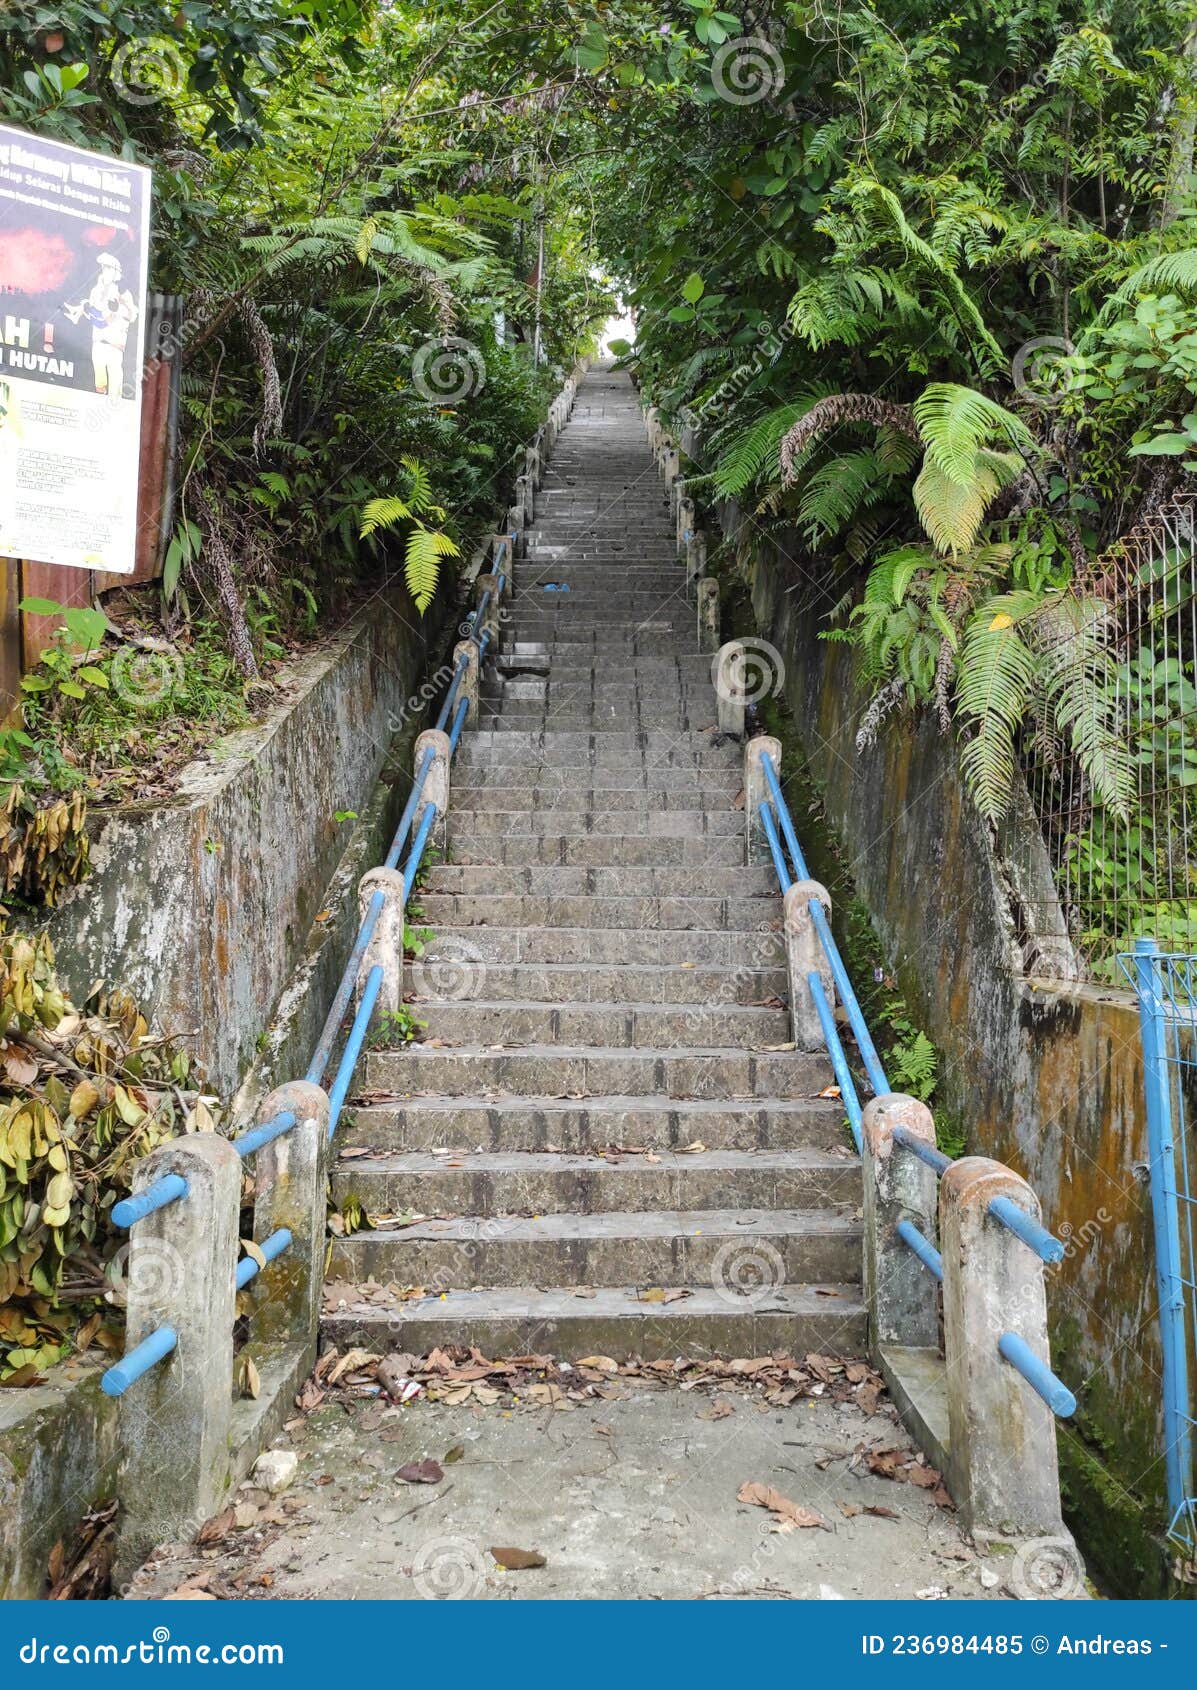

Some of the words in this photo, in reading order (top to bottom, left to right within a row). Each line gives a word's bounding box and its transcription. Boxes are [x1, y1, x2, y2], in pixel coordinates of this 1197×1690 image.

[0, 165, 22, 184] idup
[64, 184, 99, 205] Dengan
[9, 349, 74, 378] HUTAN
